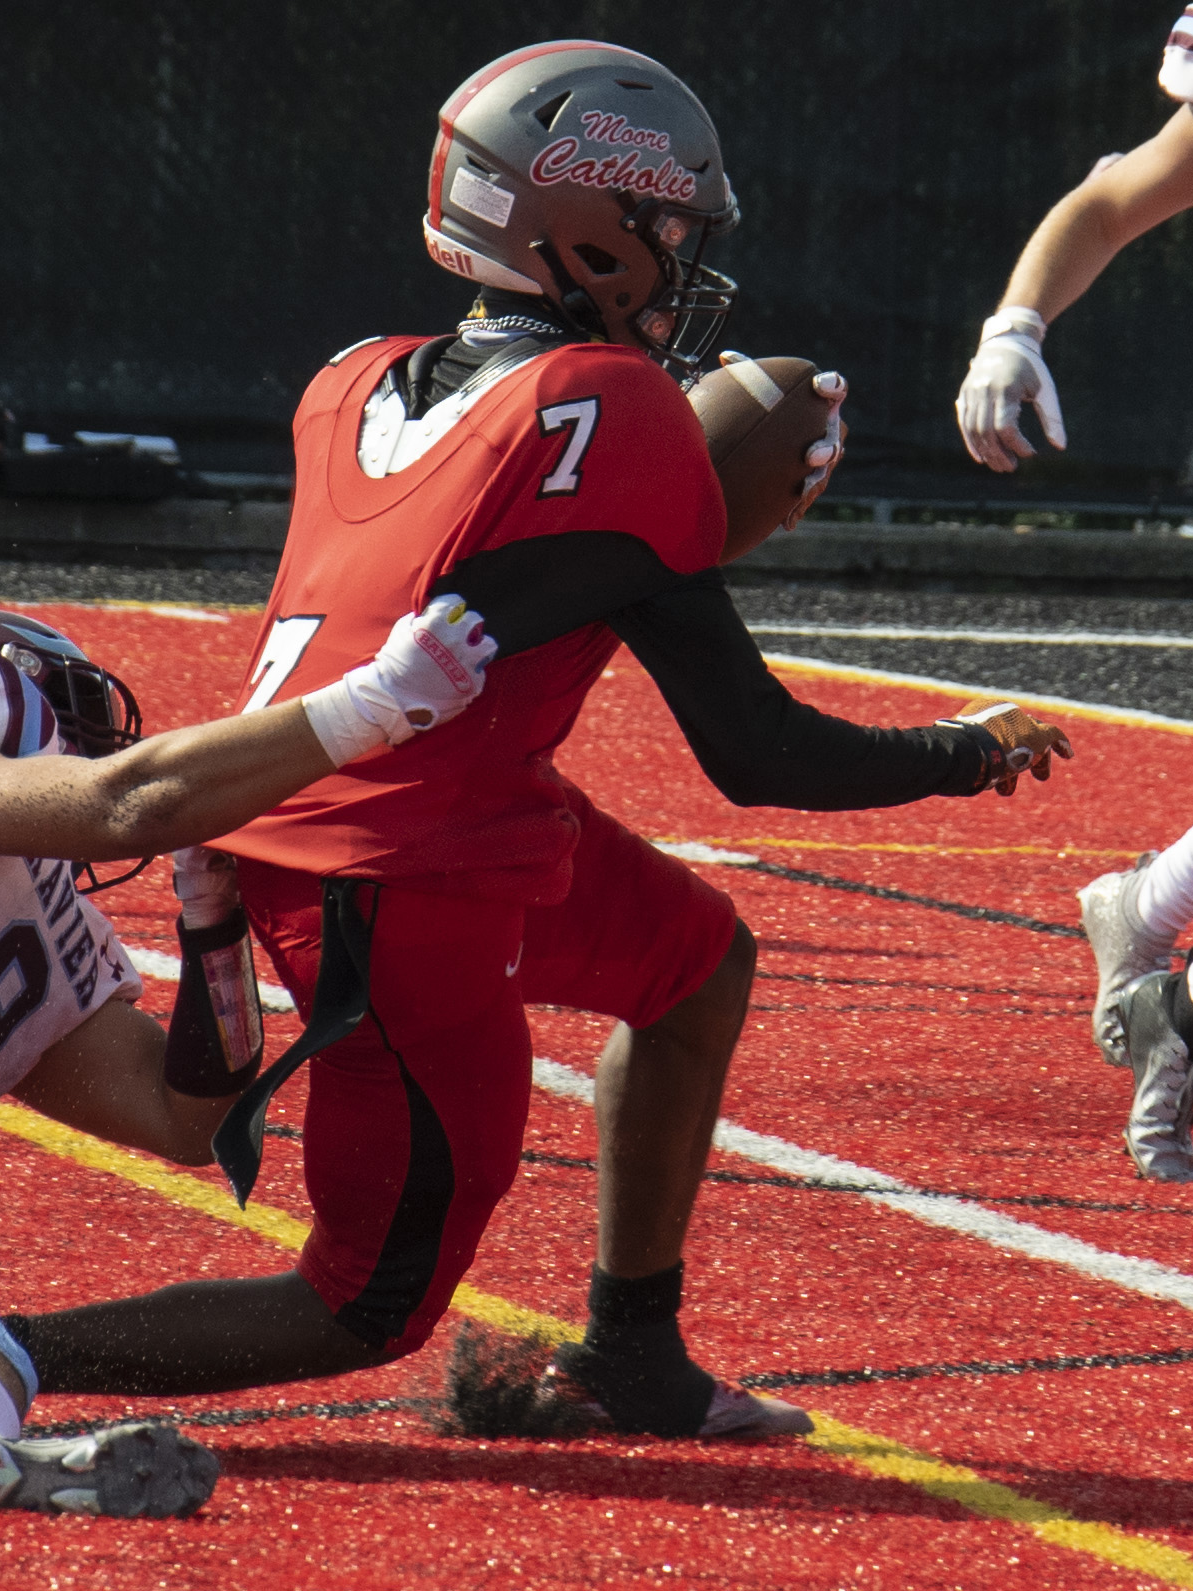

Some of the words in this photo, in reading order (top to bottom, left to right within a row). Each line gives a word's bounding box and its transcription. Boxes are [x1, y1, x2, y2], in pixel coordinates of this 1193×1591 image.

[581, 110, 670, 151] Moore
[530, 136, 696, 200] Catholic
[426, 238, 473, 276] dell
[535, 395, 602, 500] 7
